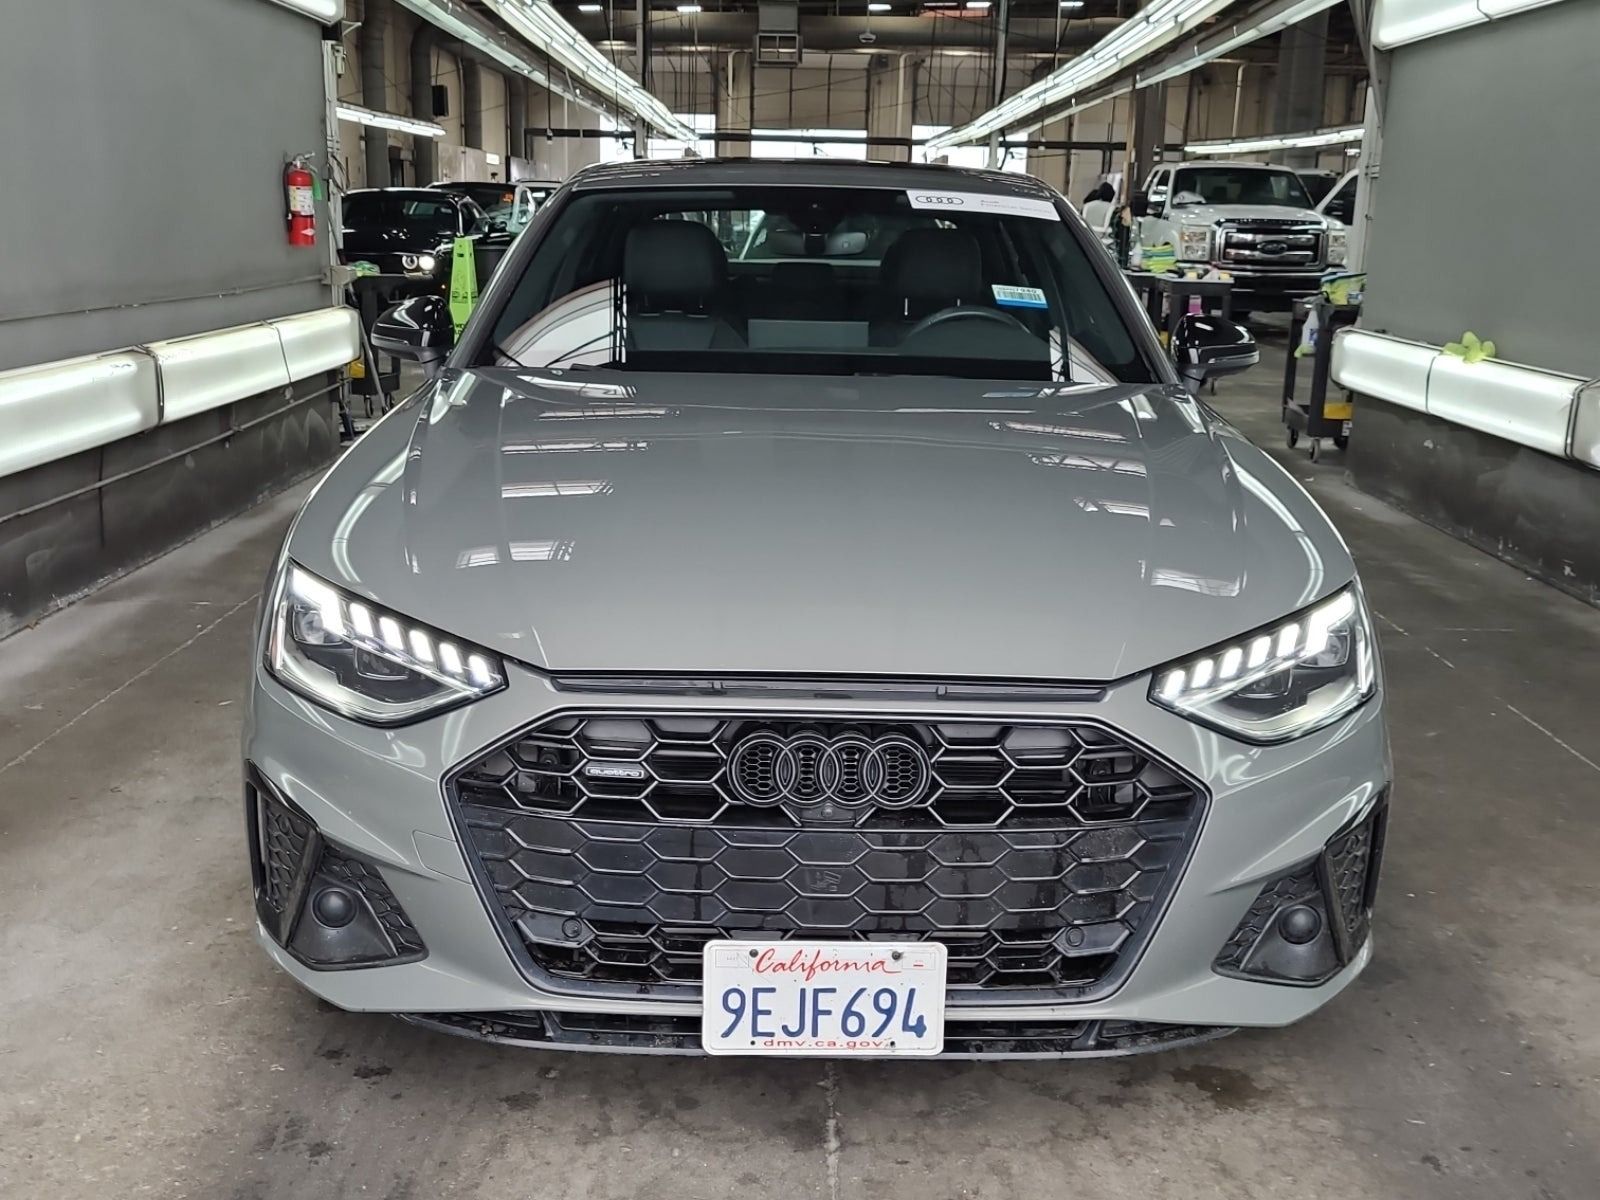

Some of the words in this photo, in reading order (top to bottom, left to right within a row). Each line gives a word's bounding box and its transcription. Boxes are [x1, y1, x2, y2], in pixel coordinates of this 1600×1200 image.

[756, 948, 902, 981] California
[721, 987, 927, 1038] 9EJF694
[763, 1038, 883, 1050] dmv.ca.gov
